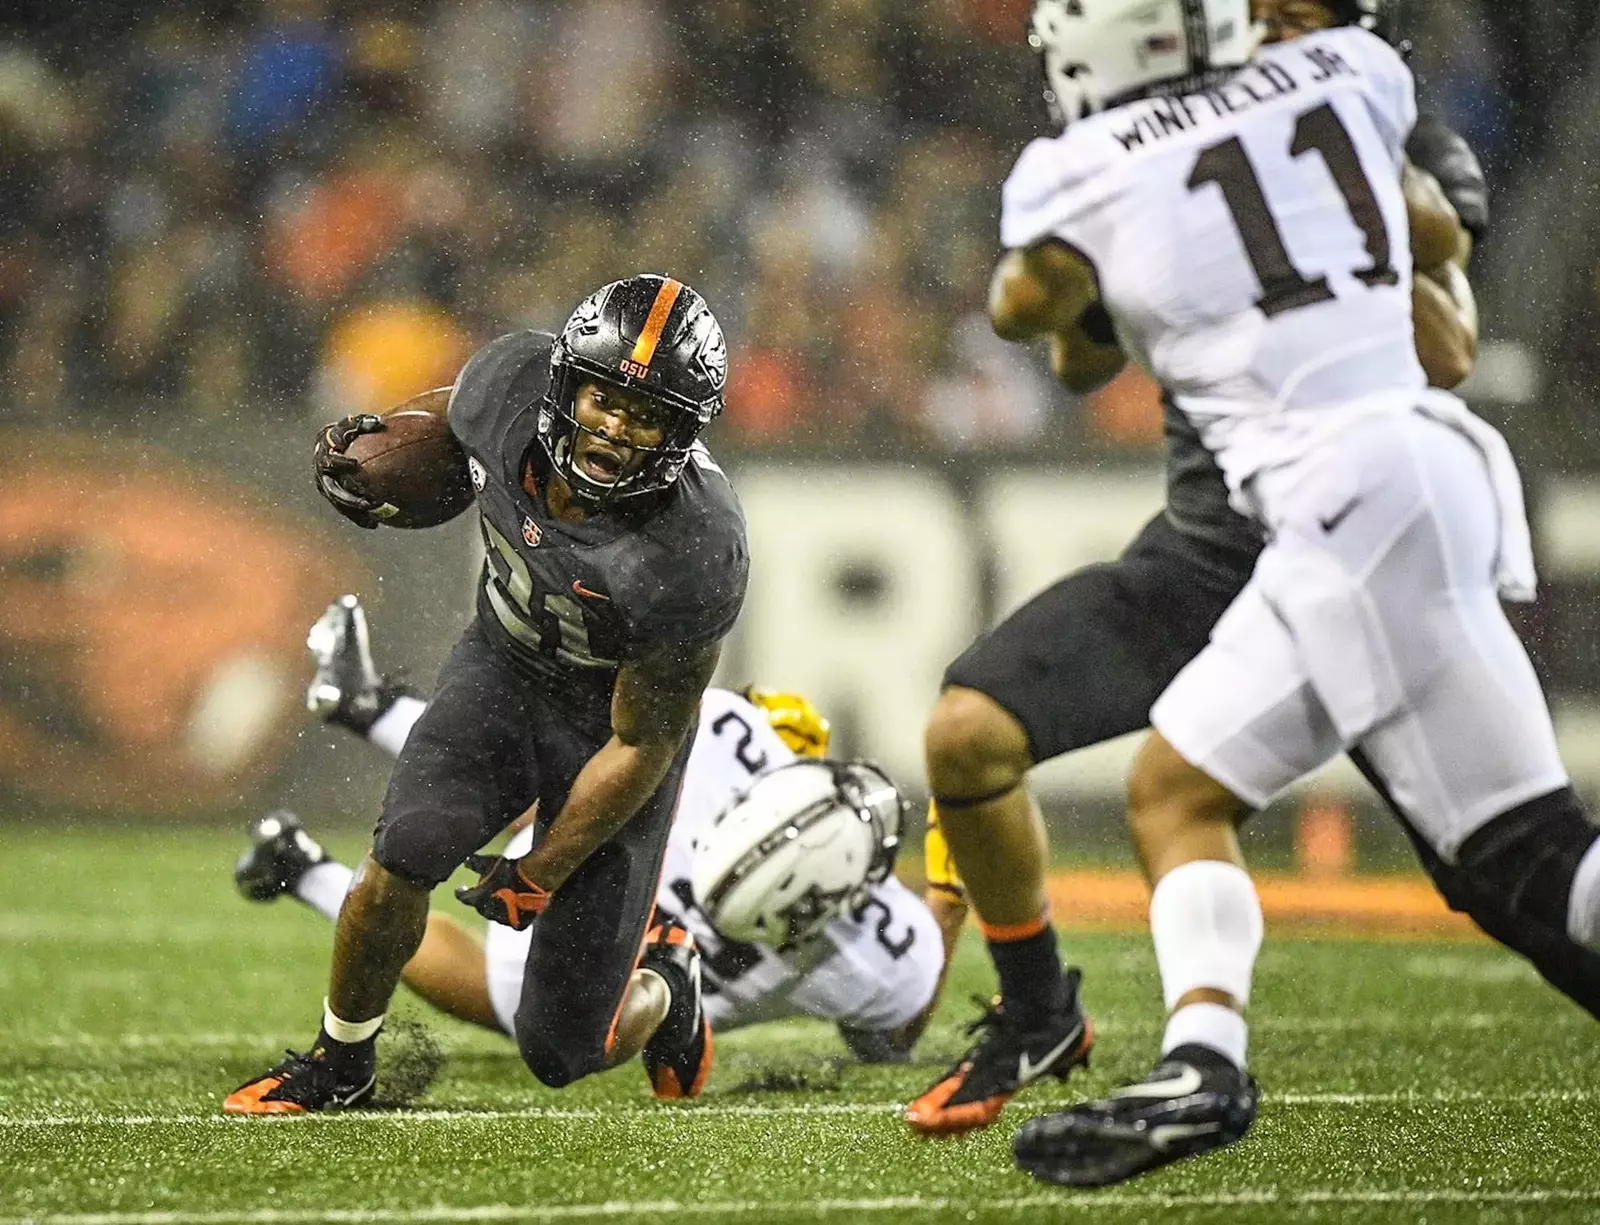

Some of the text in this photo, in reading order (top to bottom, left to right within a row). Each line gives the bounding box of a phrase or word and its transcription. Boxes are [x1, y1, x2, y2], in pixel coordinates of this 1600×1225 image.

[1112, 61, 1298, 152] WINFIELD
[1186, 102, 1399, 319] 11
[619, 359, 649, 379] OSU
[711, 709, 768, 774] 2
[852, 896, 915, 960] 2
